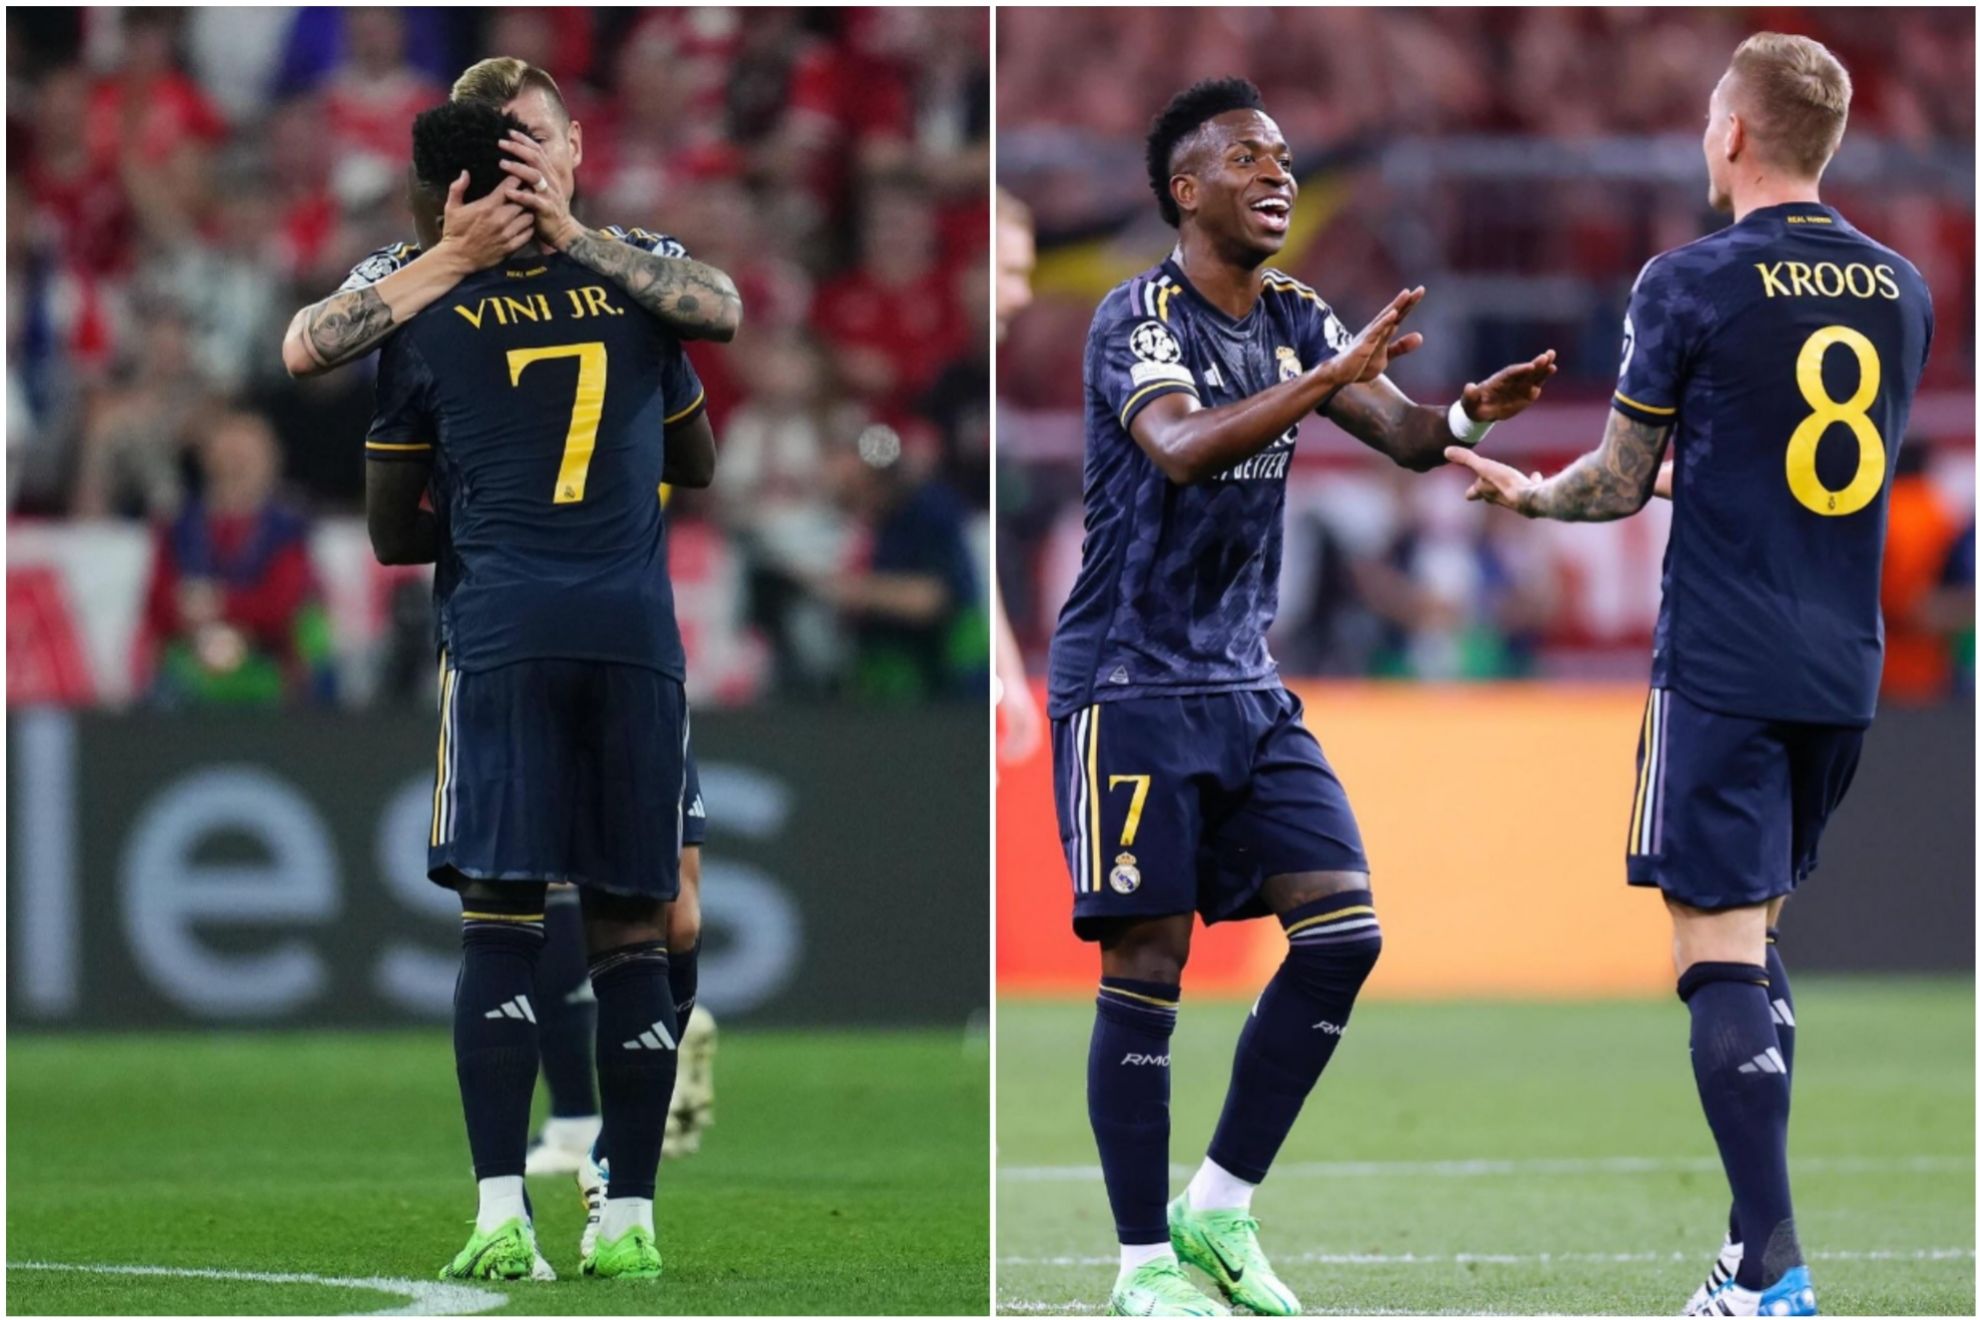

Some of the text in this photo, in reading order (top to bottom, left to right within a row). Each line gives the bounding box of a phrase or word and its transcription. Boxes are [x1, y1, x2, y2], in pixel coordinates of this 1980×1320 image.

[453, 286, 625, 330] VINI JR.
[1754, 261, 1900, 300] KROOS
[506, 341, 608, 504] 7
[1785, 324, 1886, 517] 8
[1108, 774, 1151, 846] 7
